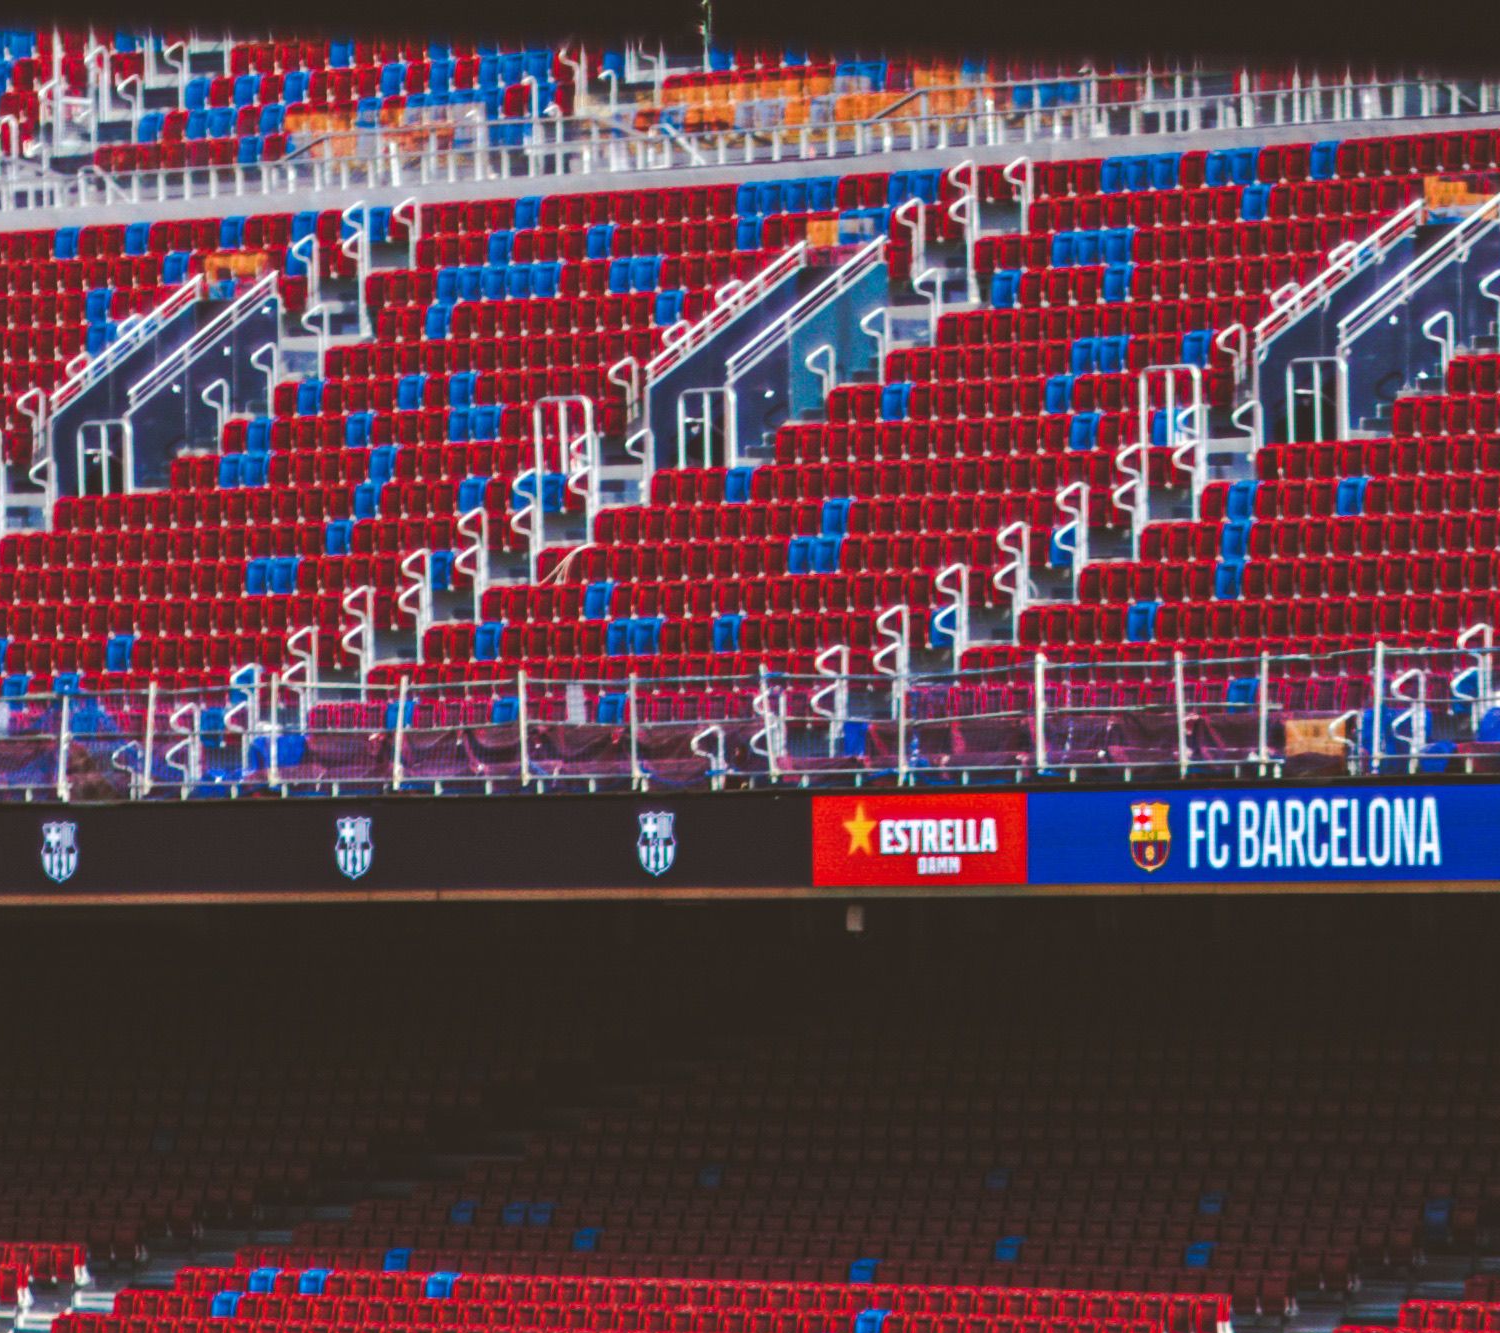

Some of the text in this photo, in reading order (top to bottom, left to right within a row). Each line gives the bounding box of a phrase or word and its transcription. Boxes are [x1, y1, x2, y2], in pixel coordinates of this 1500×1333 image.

[879, 817, 999, 855] ESTRELLA
[1189, 796, 1442, 869] FC BARCELONA
